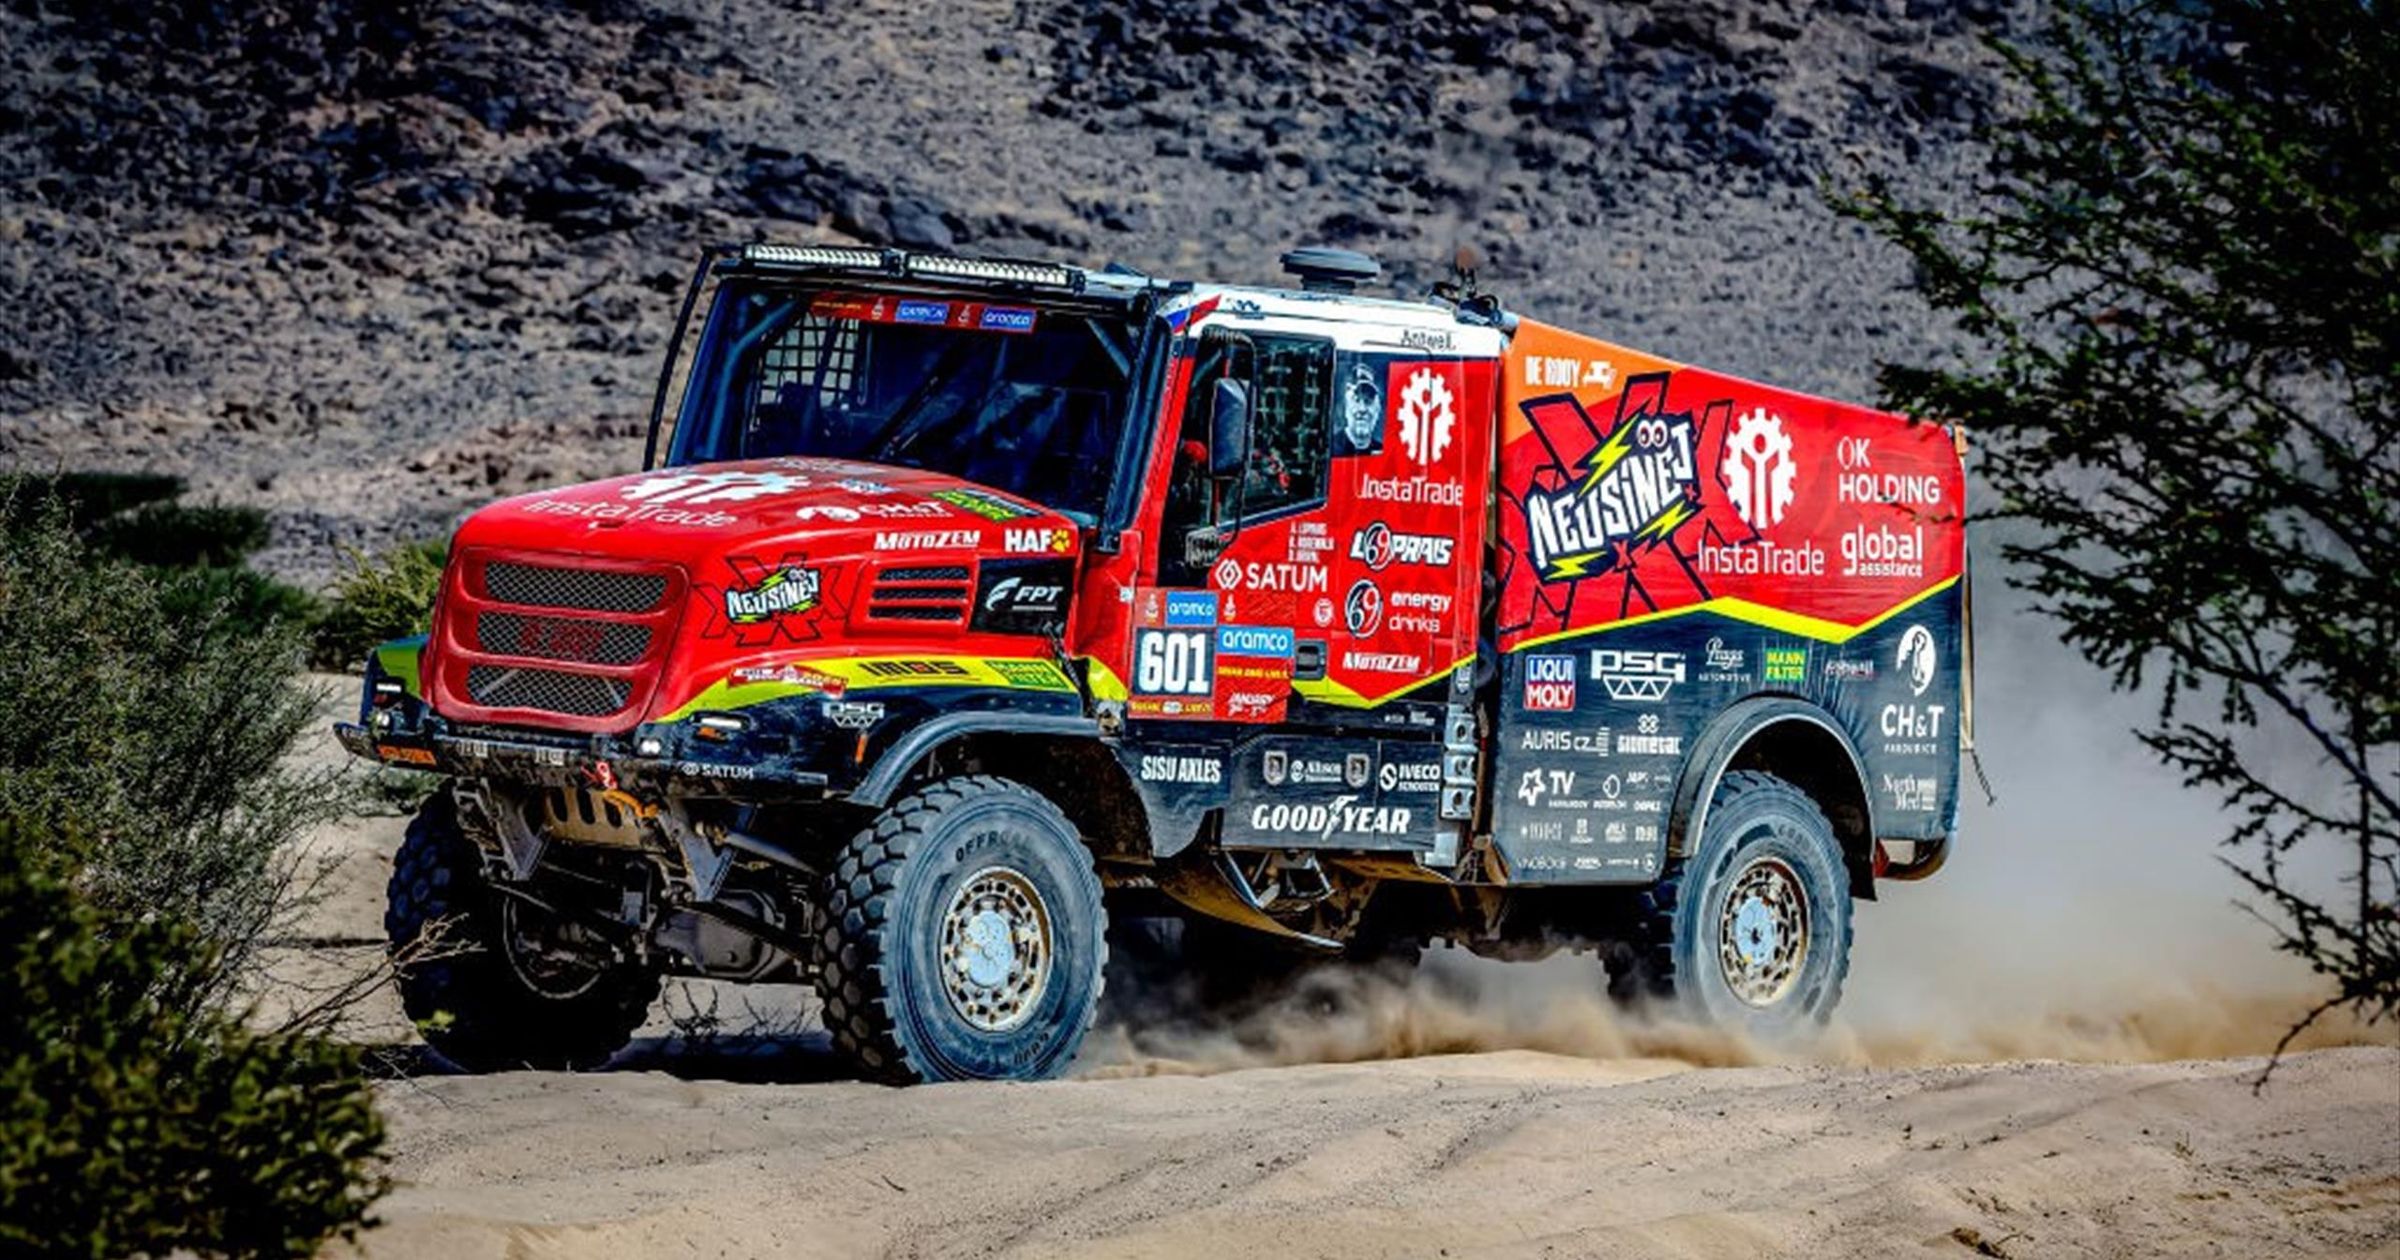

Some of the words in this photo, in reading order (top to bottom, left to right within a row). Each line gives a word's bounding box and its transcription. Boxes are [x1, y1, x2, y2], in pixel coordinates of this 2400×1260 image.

[1837, 436, 1871, 471] OK
[1361, 475, 1463, 506] InstaTrade
[1838, 473, 1941, 504] HOLDING
[523, 499, 738, 527] InstaTrade
[1698, 539, 1825, 576] InstaTrade
[1841, 524, 1923, 576] global
[1246, 564, 1328, 592] SATUM
[1014, 585, 1063, 602] FPT
[1391, 593, 1452, 611] energy
[1169, 603, 1214, 616] aramco
[1388, 615, 1440, 633] drinks
[1222, 631, 1288, 651] aramco
[1138, 631, 1210, 694] 601
[1529, 659, 1572, 681] LIQUI
[1527, 684, 1573, 707] MOLY
[1881, 705, 1944, 738] CH&T
[1522, 731, 1571, 750] AURIS
[702, 765, 754, 779] SATUM
[1141, 755, 1177, 781] SISU
[1178, 758, 1221, 784] AXLES
[1399, 764, 1441, 780] IVECO
[1549, 771, 1575, 795] TV
[1252, 795, 1411, 841] GOODYEAR
